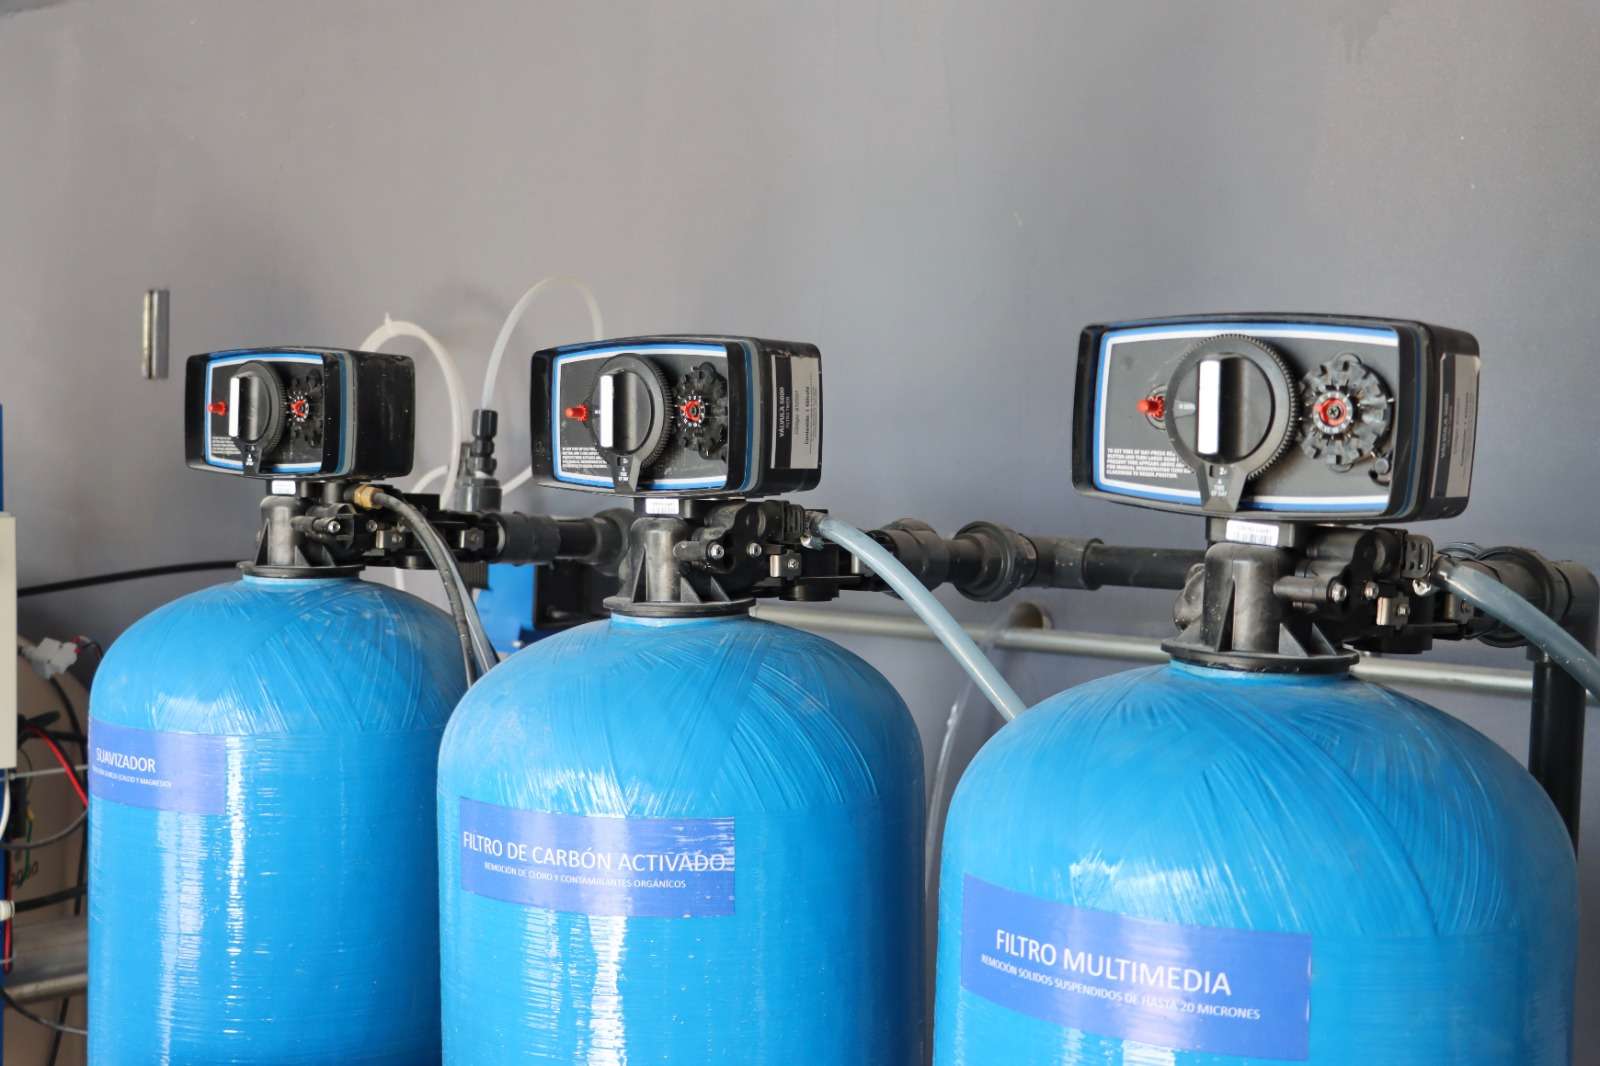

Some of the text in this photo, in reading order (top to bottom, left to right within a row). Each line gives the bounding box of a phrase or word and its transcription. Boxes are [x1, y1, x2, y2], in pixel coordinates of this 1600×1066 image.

[96, 747, 157, 773] SUAVIZADOR
[462, 831, 726, 872] FILTRO DE CARBÓN ACTIVADO
[634, 877, 687, 888] ORGÁNICOS
[995, 928, 1232, 996] FILTRO MULTIMEDIA
[1054, 978, 1123, 1002] SUSPENDIDOS
[1142, 993, 1178, 1010] HASTA
[1181, 1001, 1195, 1013] 20
[1196, 1003, 1261, 1020] MICRONES
